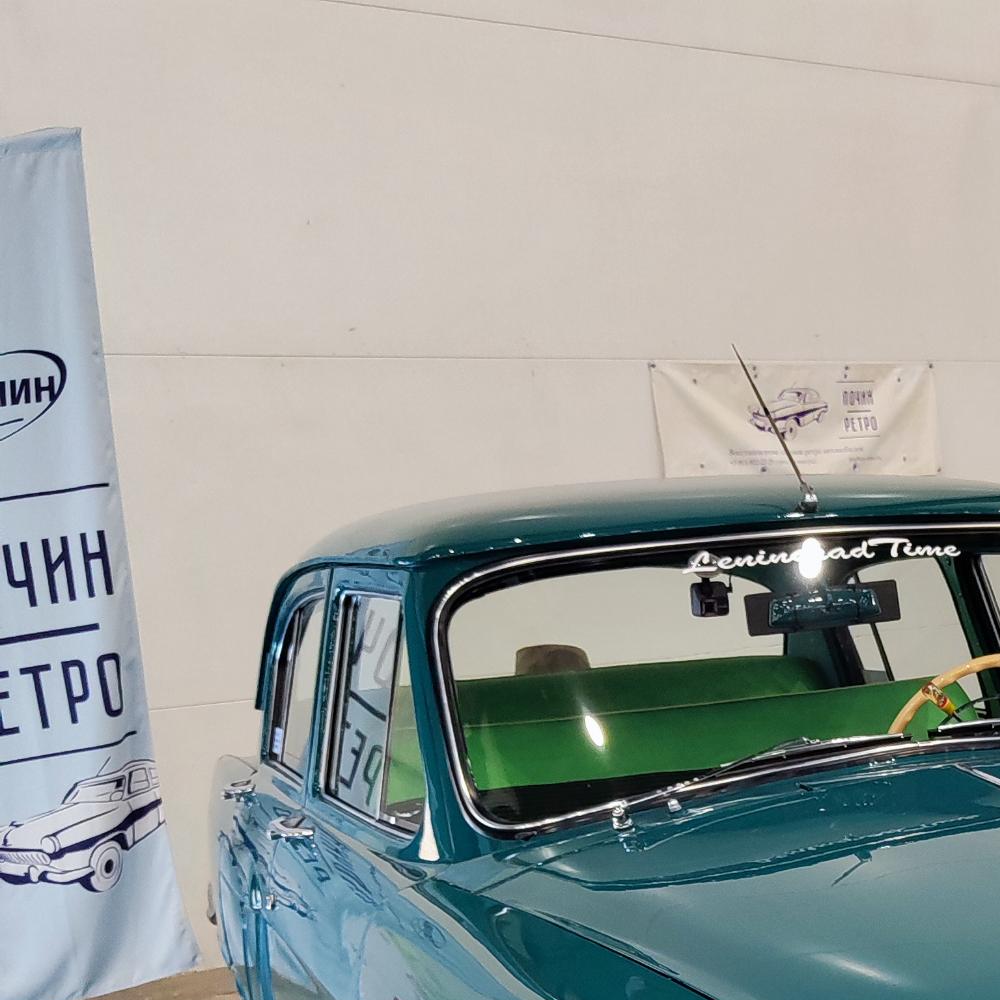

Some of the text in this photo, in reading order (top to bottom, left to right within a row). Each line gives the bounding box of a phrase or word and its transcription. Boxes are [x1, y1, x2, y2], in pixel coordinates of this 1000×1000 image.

[842, 390, 874, 406] ПОЧИН
[843, 416, 878, 432] РЕТРО
[682, 538, 961, 574] Leninad Time
